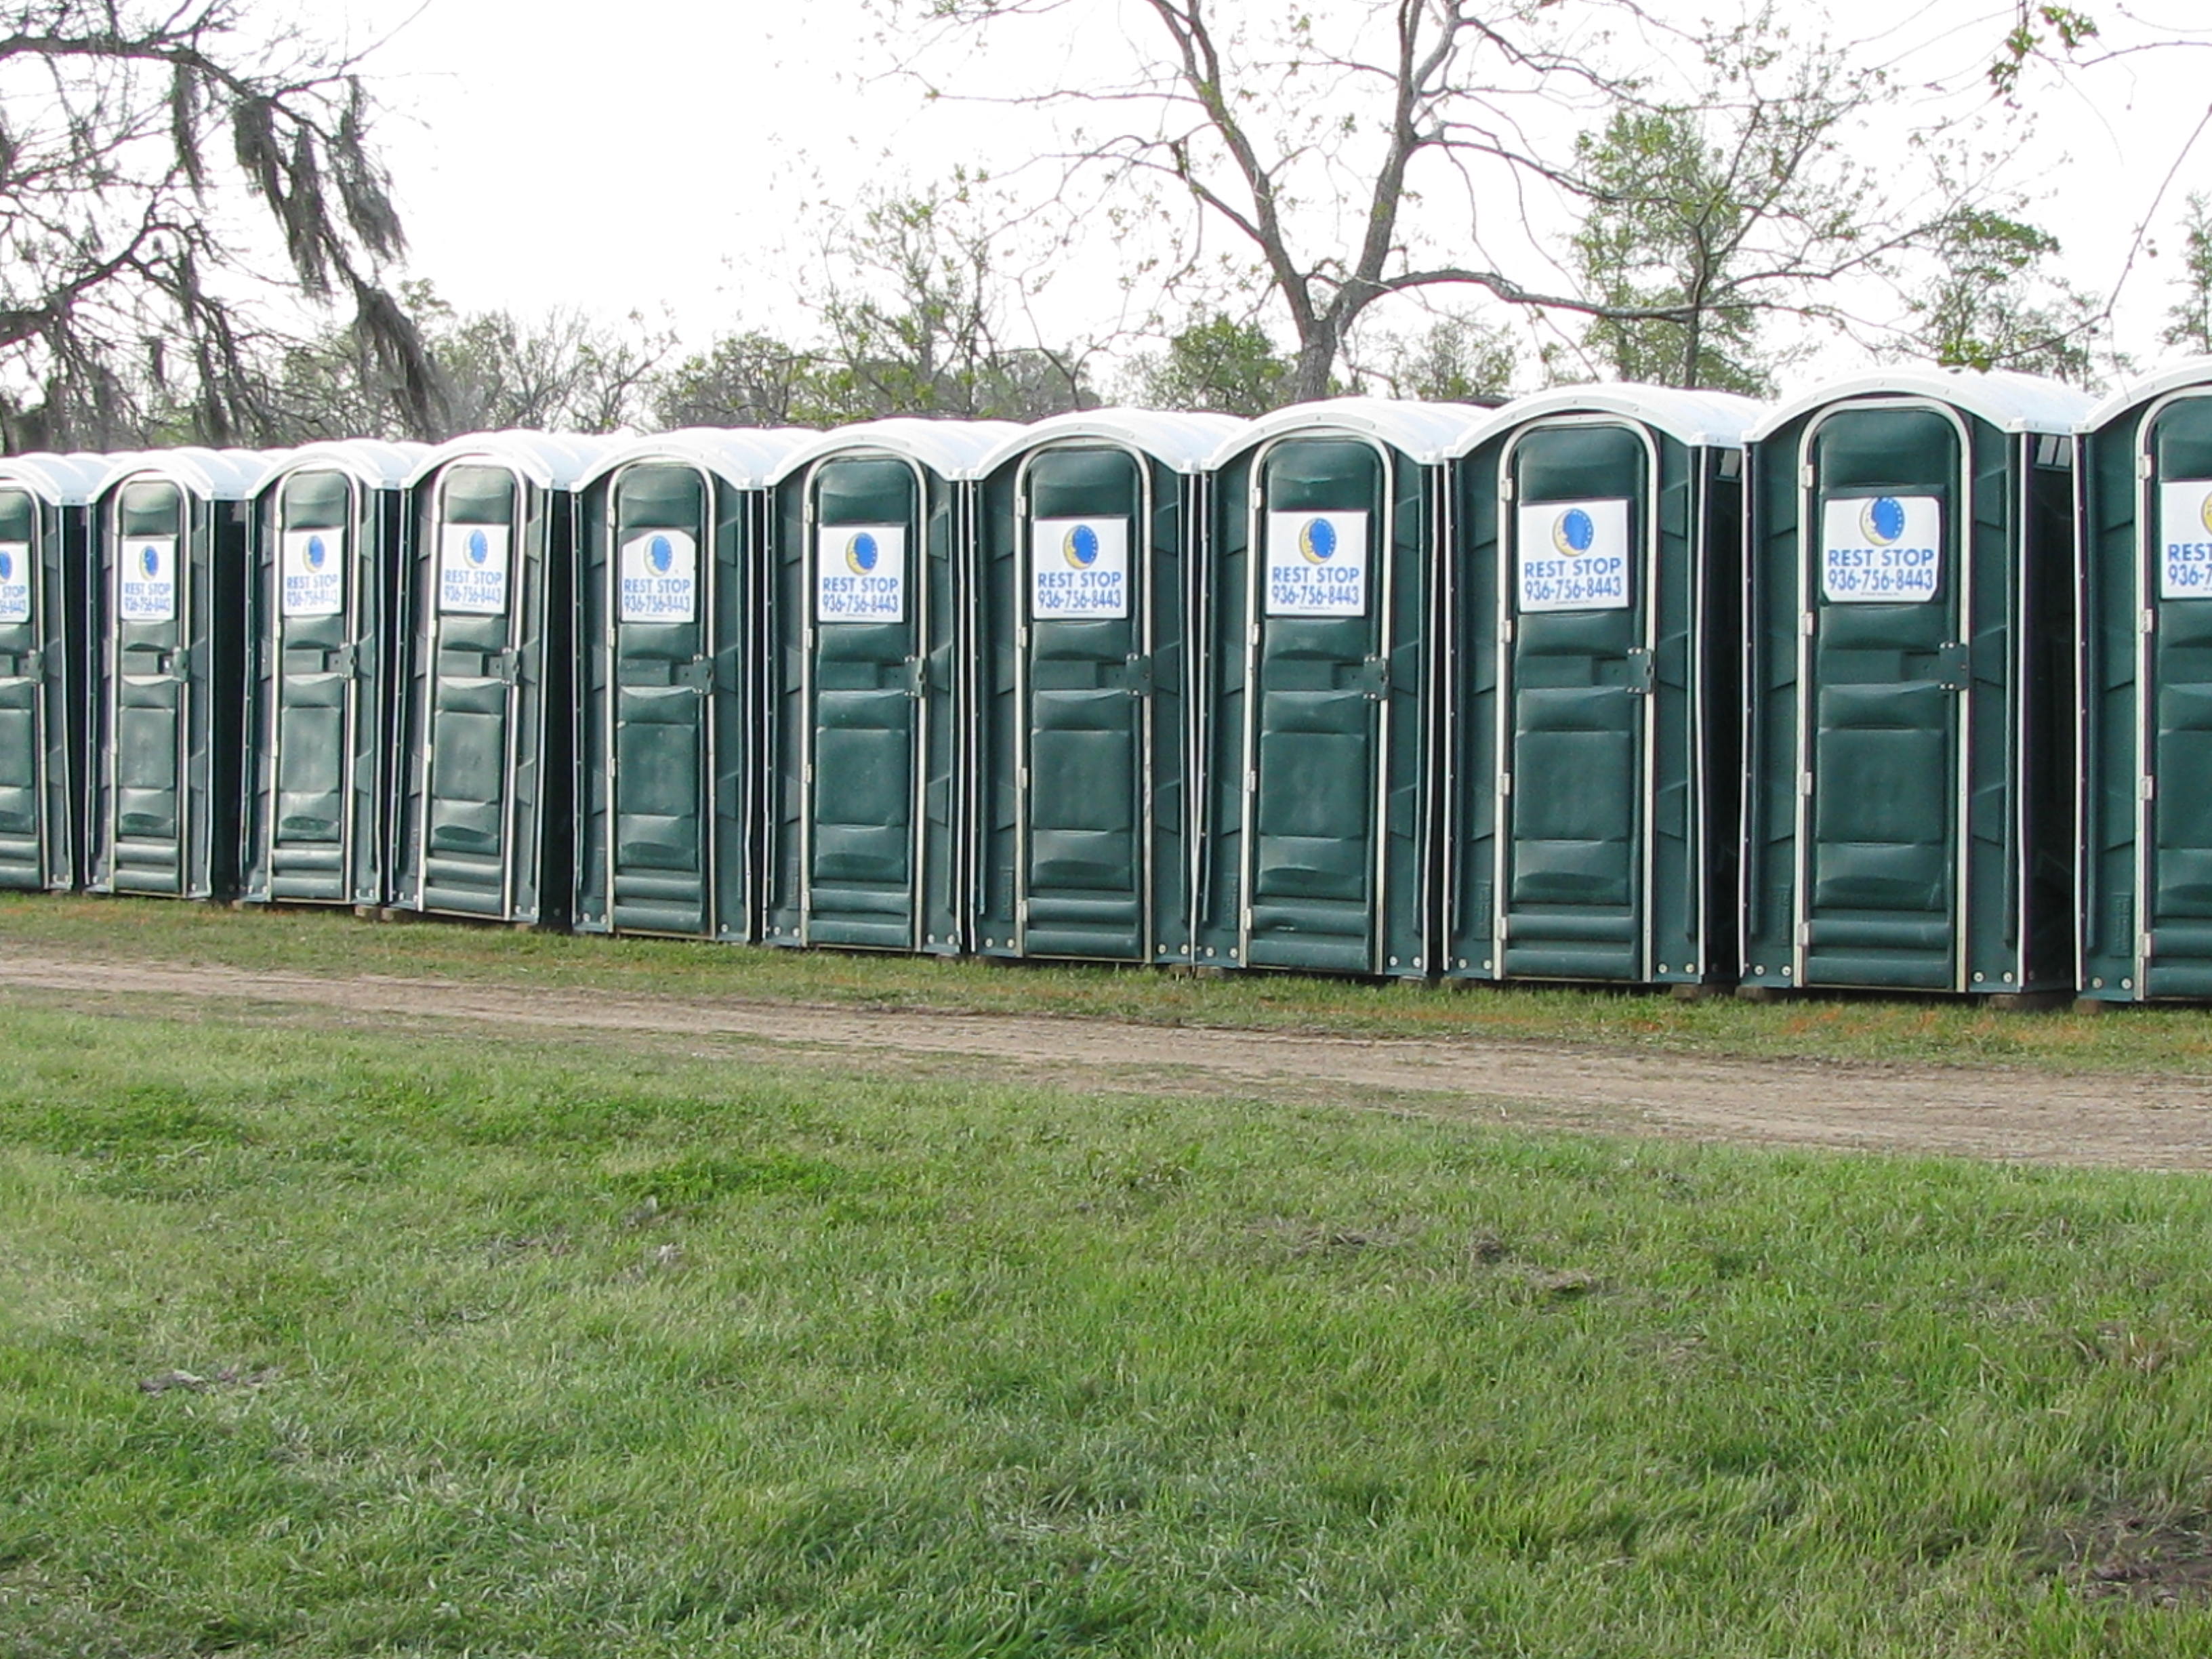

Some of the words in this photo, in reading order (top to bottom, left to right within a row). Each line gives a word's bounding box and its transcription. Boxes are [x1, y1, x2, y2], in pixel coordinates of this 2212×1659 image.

[1828, 550, 1873, 567] REST
[1881, 549, 1933, 567] STOP
[1272, 567, 1309, 583] REST
[1316, 567, 1359, 583] STOP
[1524, 560, 1566, 577] REST
[1572, 558, 1622, 576] STOP
[287, 576, 310, 589] REST
[313, 574, 337, 588] STOP
[445, 569, 470, 583] REST
[474, 571, 501, 585] STOP
[624, 579, 653, 593] REST
[657, 579, 690, 593] STOP
[823, 577, 855, 592] REST
[861, 577, 898, 592] STOP
[1038, 573, 1073, 588] REST
[1080, 571, 1122, 588] STOP
[1828, 569, 1933, 590] 936-756-8443
[125, 583, 145, 594] REST
[148, 583, 171, 595] STOP
[1272, 585, 1359, 605] 936-756-8443
[1525, 577, 1622, 600] 936-756-8443
[624, 595, 690, 613] 936-756-8443
[823, 594, 898, 613] 936-756-8443
[1038, 589, 1122, 609] 936-756-8443
